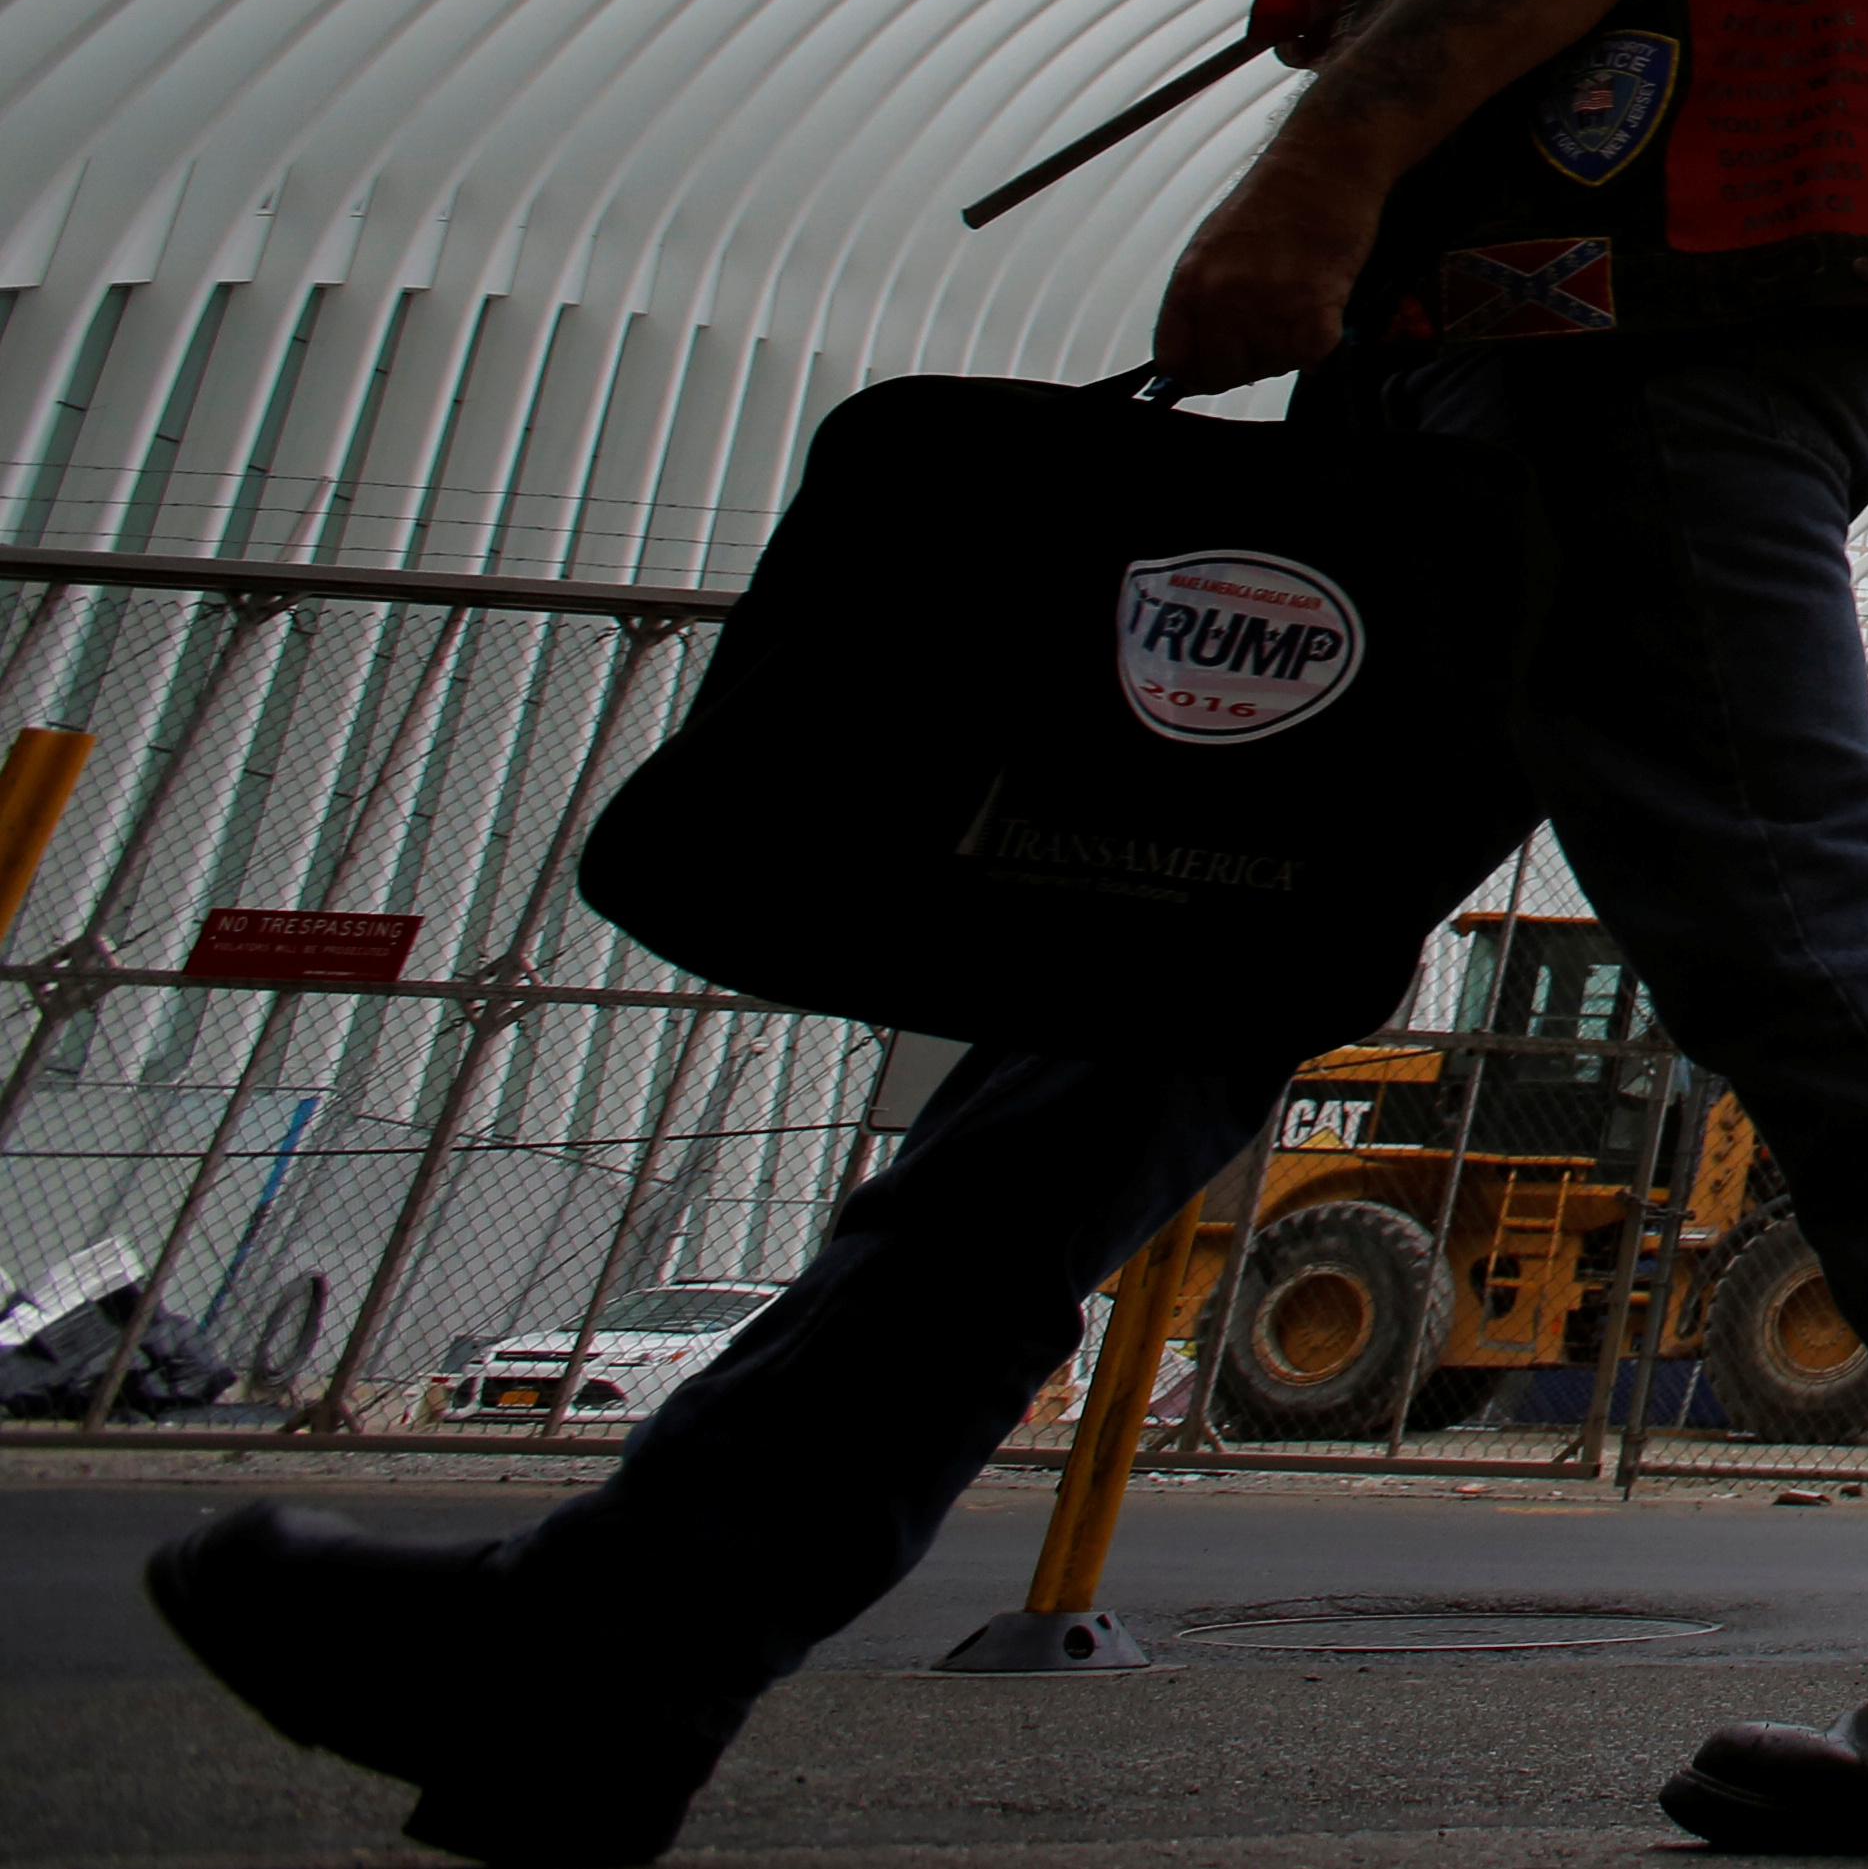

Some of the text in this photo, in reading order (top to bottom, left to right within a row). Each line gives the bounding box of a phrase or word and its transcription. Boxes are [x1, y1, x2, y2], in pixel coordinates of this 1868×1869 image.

[1626, 79, 1657, 128] JERSEY
[1129, 589, 1344, 681] TRUMP
[1139, 679, 1258, 718] 2016
[995, 818, 1293, 892] TRANSAMERICA
[217, 916, 404, 938] NO TRESPASSING
[1282, 1098, 1372, 1150] CAT
